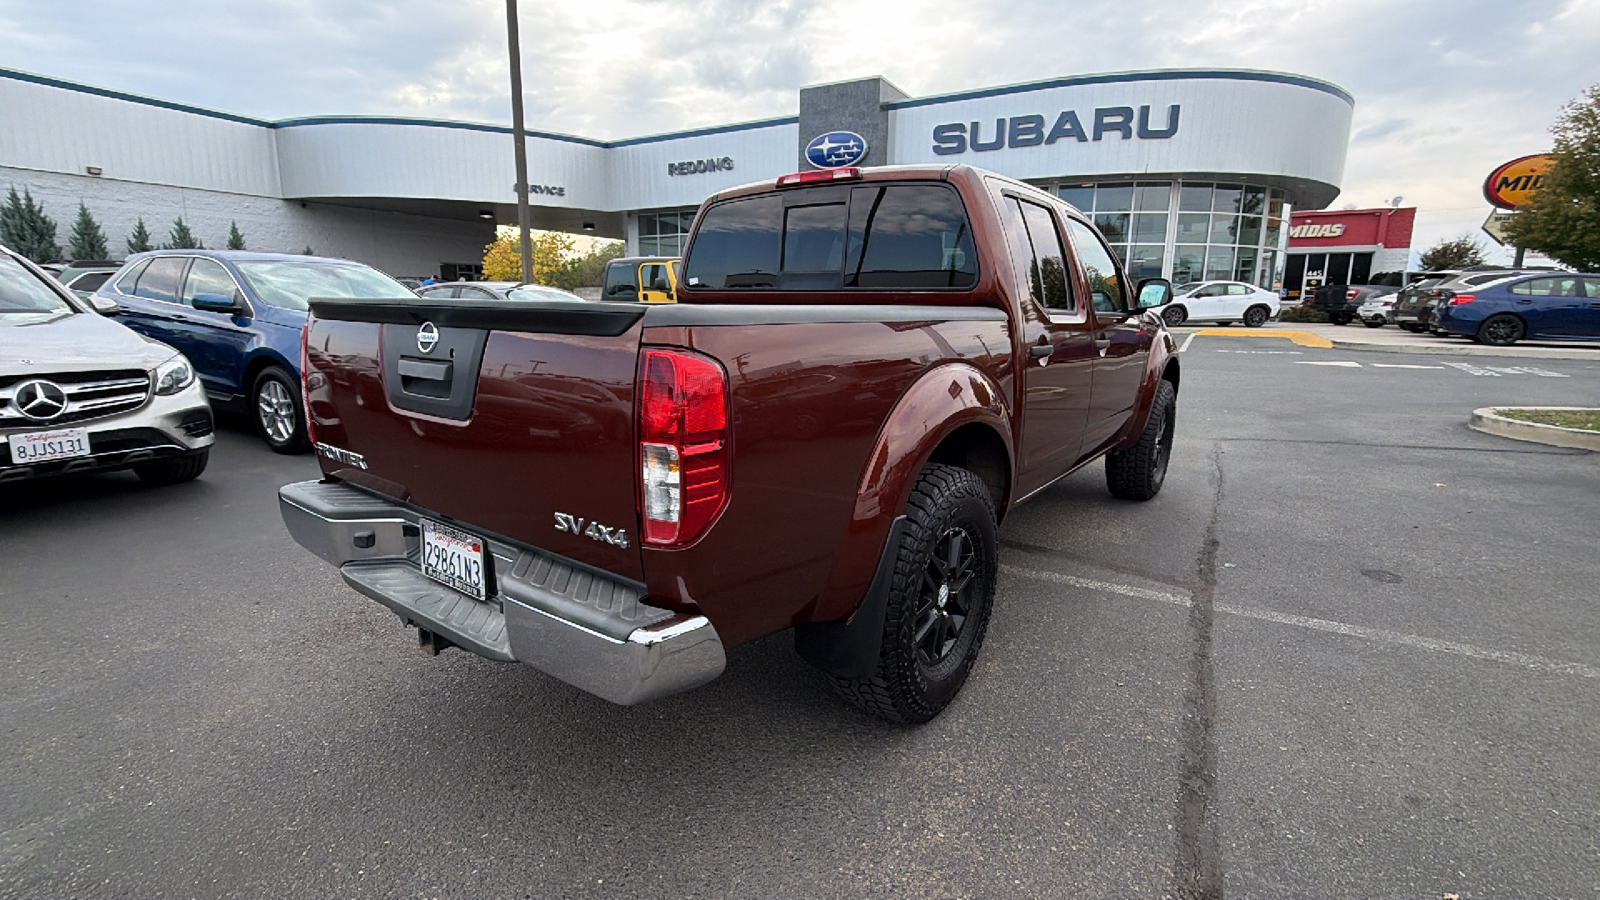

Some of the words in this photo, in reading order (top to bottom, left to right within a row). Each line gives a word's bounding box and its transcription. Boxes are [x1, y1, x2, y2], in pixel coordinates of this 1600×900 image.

[932, 104, 1181, 156] SUBARU
[668, 156, 734, 177] REDDING
[1289, 223, 1347, 239] MIDAS
[1307, 269, 1323, 277] 445
[17, 438, 85, 459] 8JJS131
[554, 511, 584, 536] SV
[426, 541, 481, 587] 29861N3
